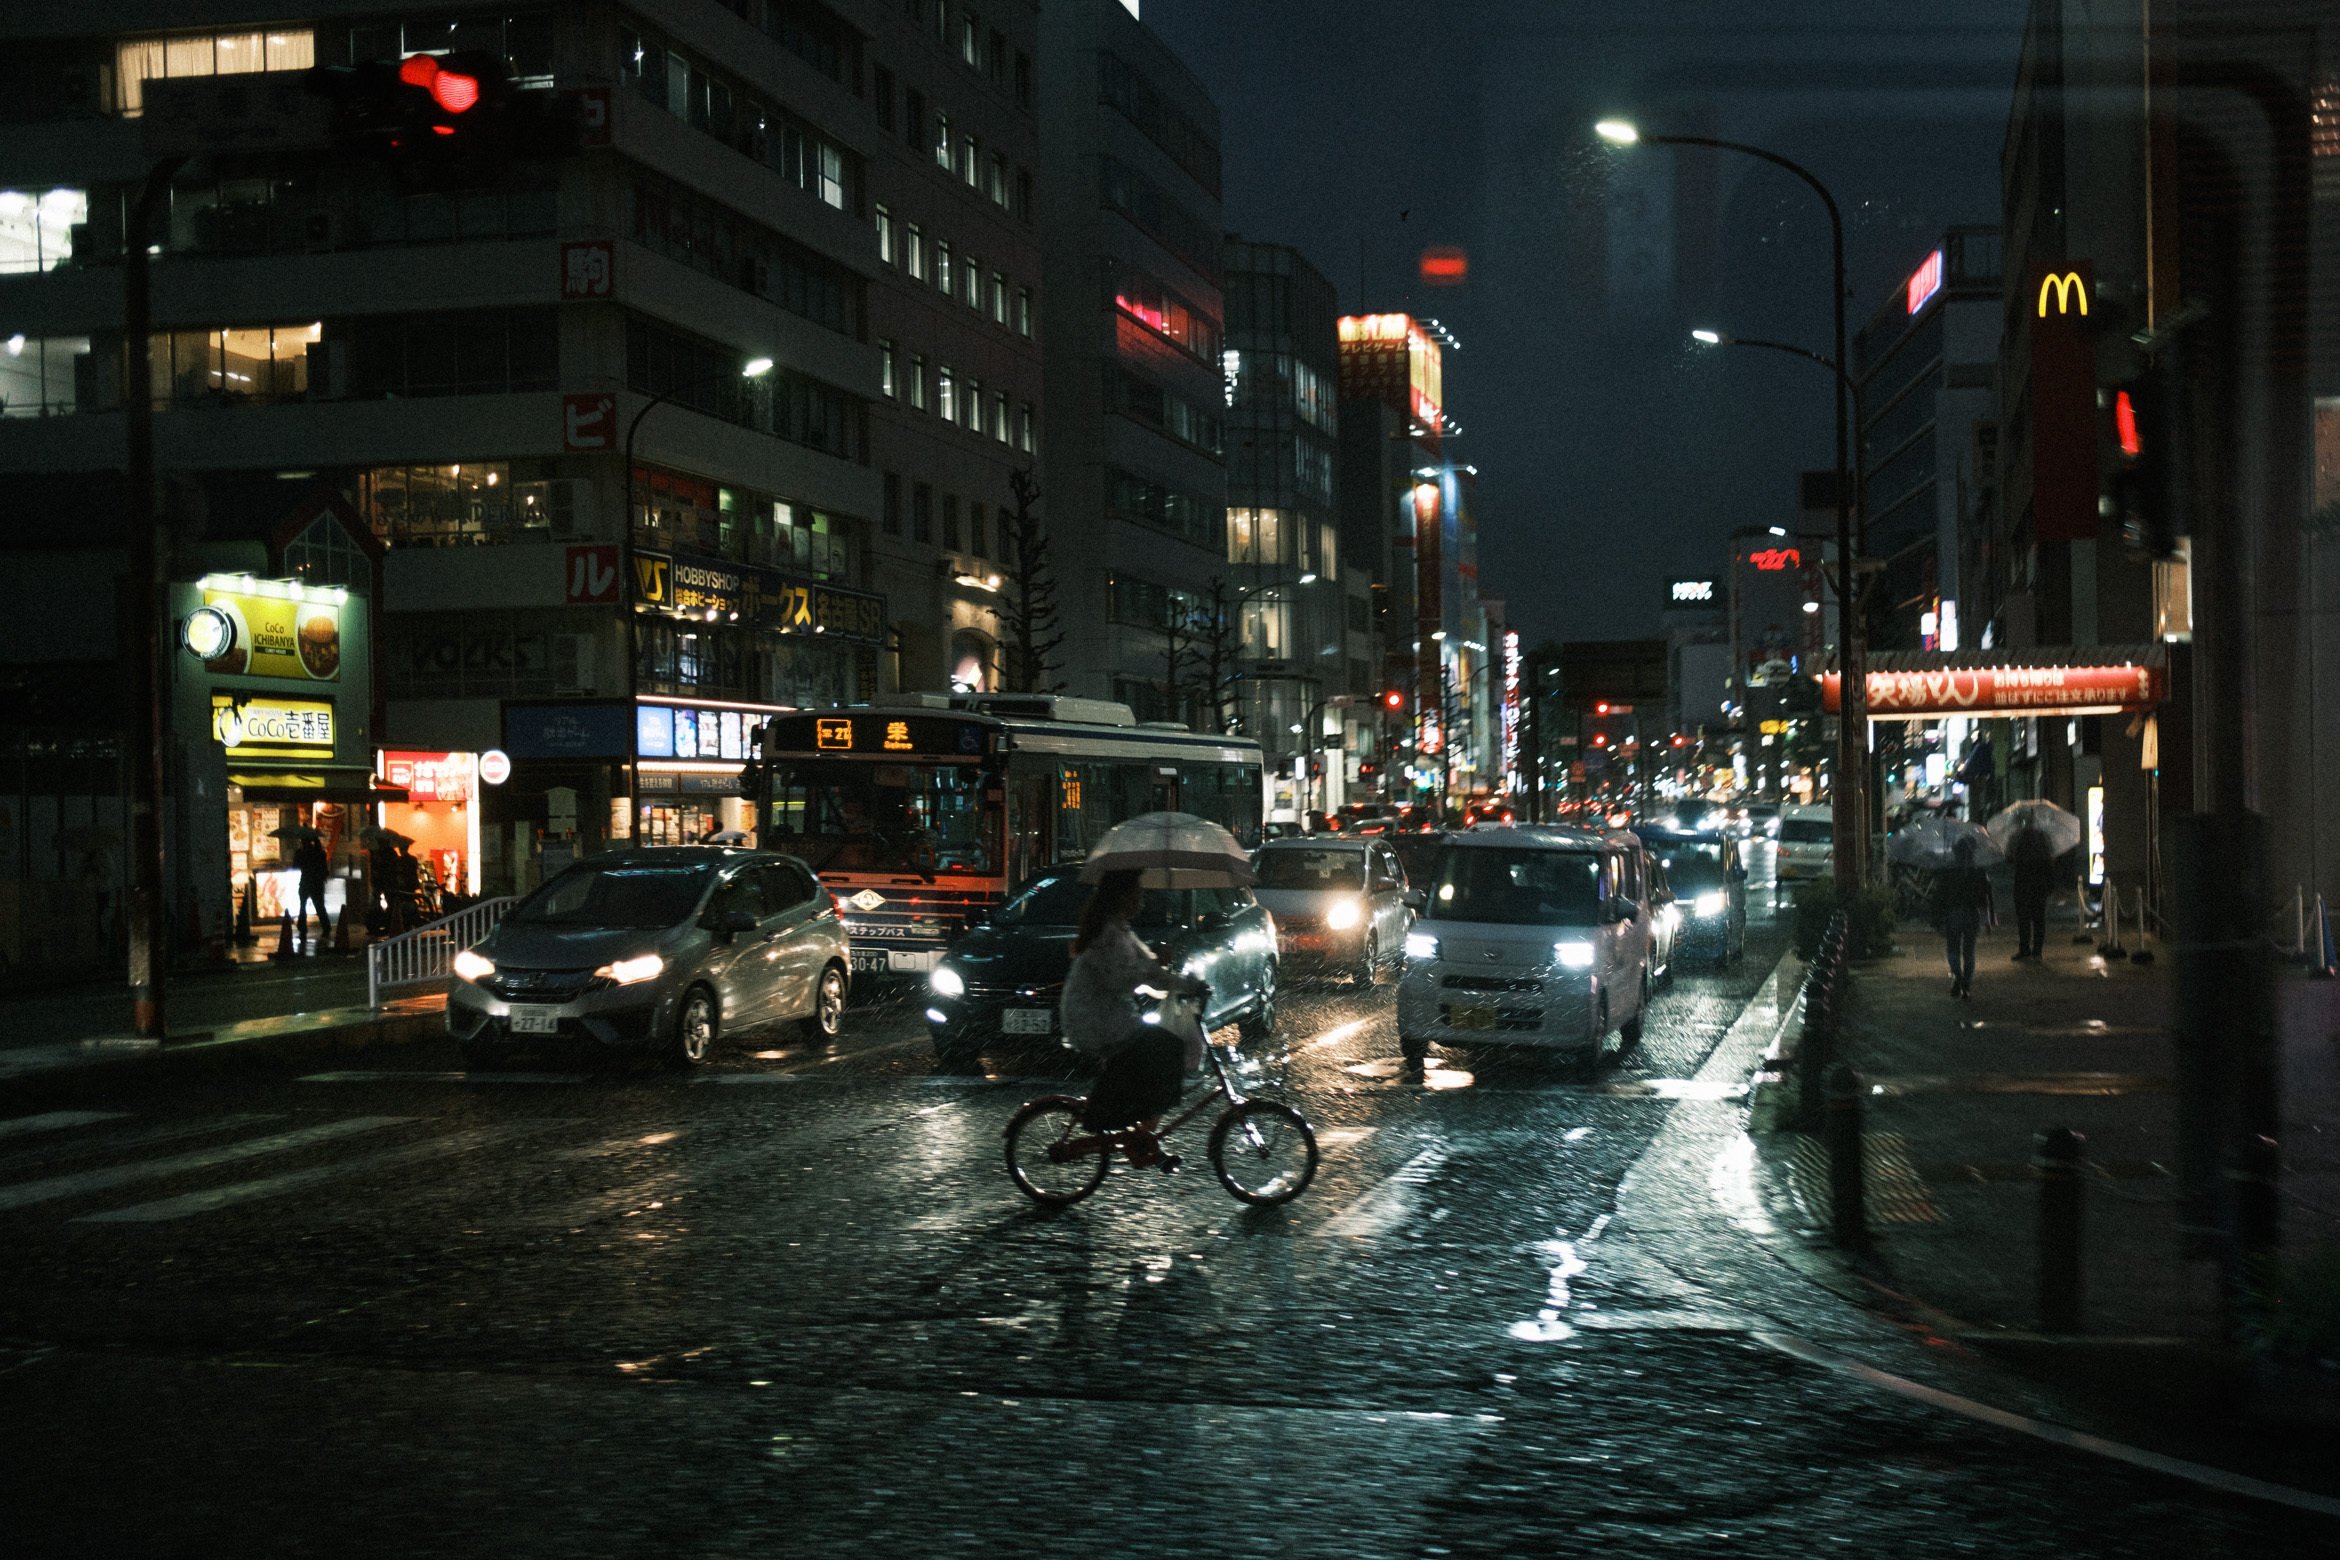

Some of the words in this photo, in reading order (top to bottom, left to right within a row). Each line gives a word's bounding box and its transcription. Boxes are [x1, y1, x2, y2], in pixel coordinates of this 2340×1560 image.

[675, 564, 740, 592] HOBBYSHOP
[741, 575, 812, 626] ボークス
[265, 622, 285, 633] CoCo
[254, 634, 295, 648] ICHIBANYA
[887, 722, 908, 740] 栄
